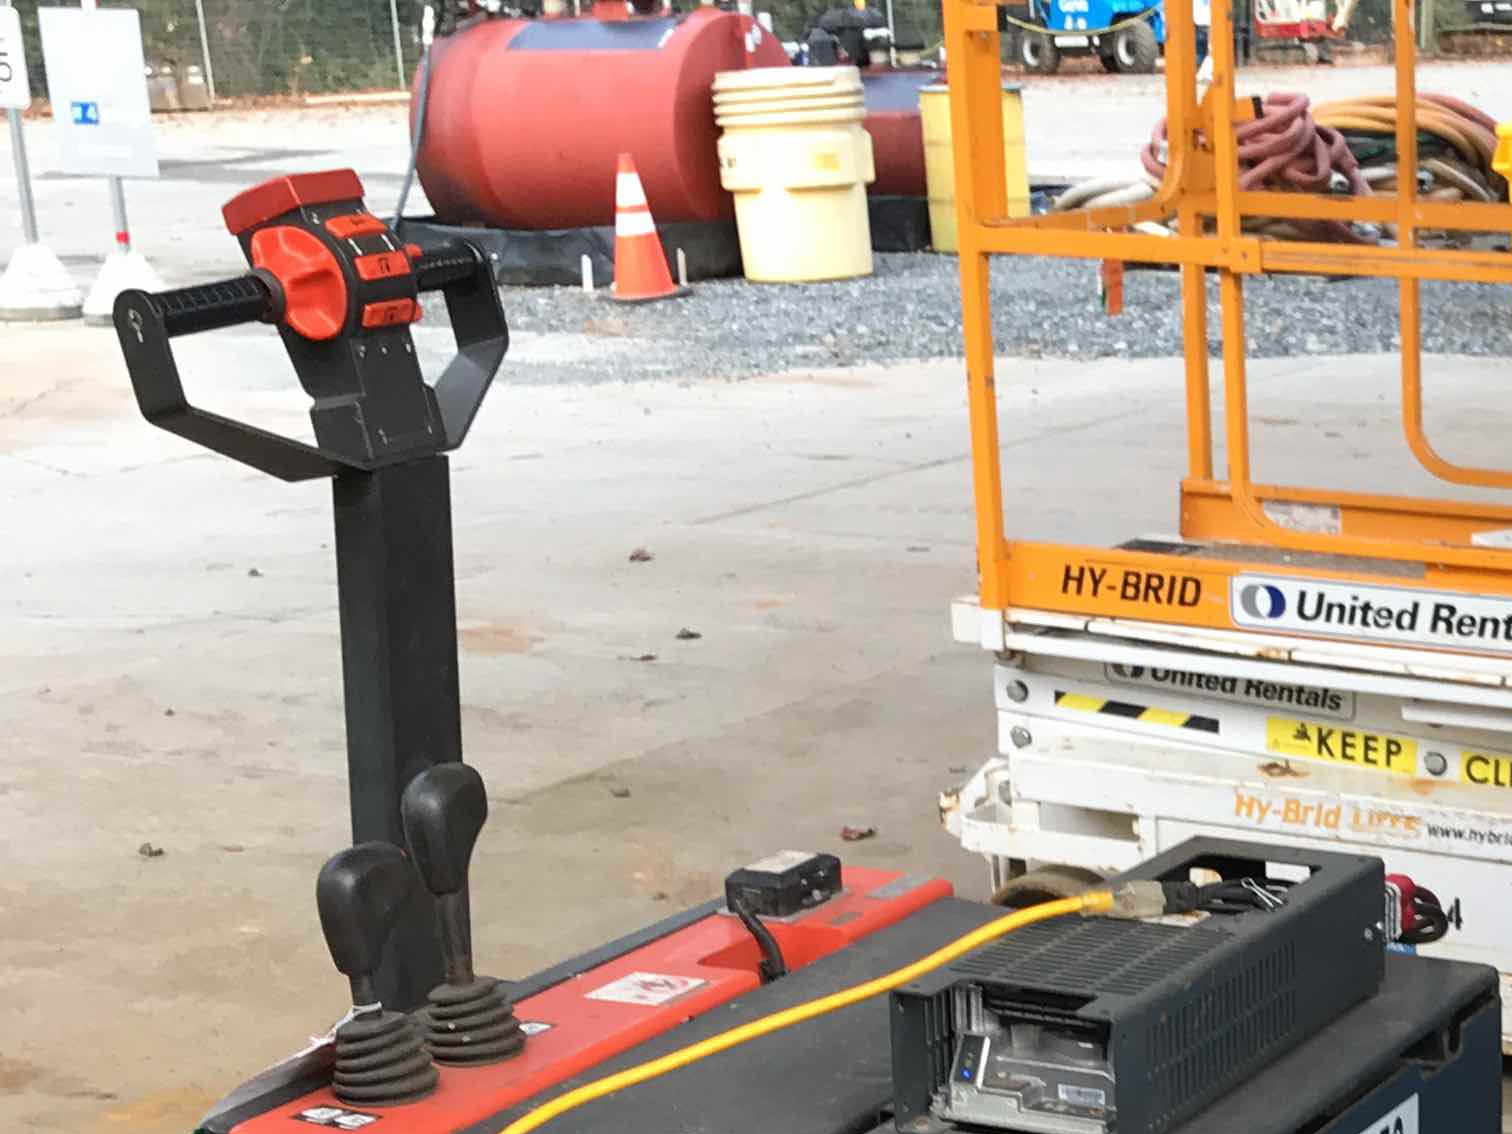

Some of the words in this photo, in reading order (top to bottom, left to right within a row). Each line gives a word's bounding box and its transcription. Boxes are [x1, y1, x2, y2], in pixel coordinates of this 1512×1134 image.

[1061, 564, 1202, 607] HY-BRID
[1297, 590, 1420, 631] United
[1316, 727, 1403, 767] KEEP
[1232, 788, 1342, 831] Hy-Brid
